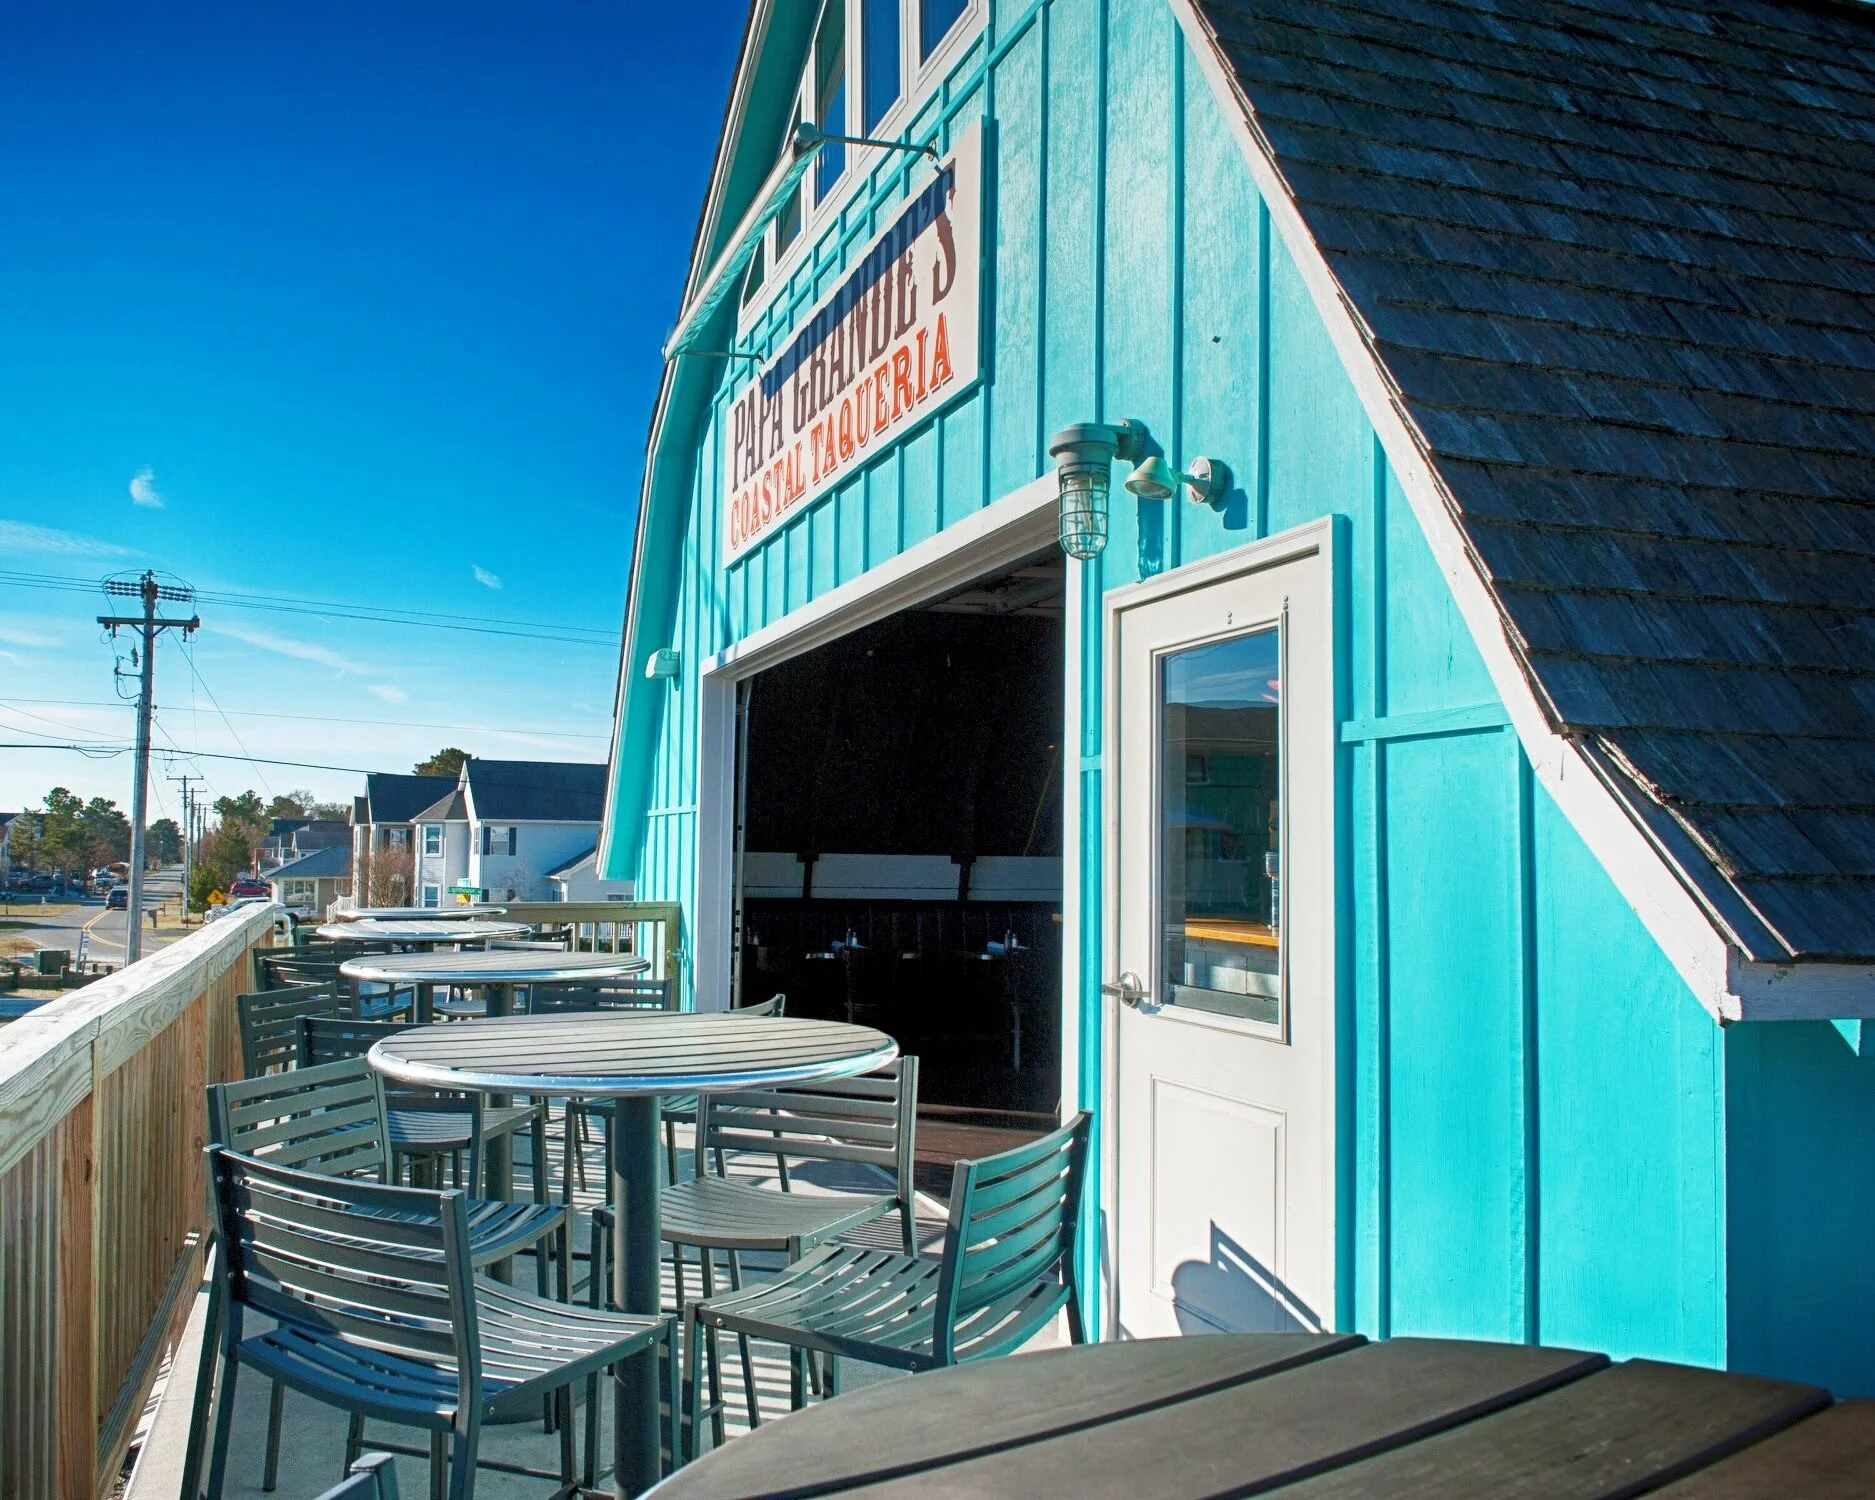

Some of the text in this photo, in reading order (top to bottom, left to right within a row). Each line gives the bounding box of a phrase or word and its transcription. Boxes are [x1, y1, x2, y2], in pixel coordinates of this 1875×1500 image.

[731, 312, 953, 549] COASTAL TAQUERIA
[733, 158, 956, 493] PAPA GRANDE'S
